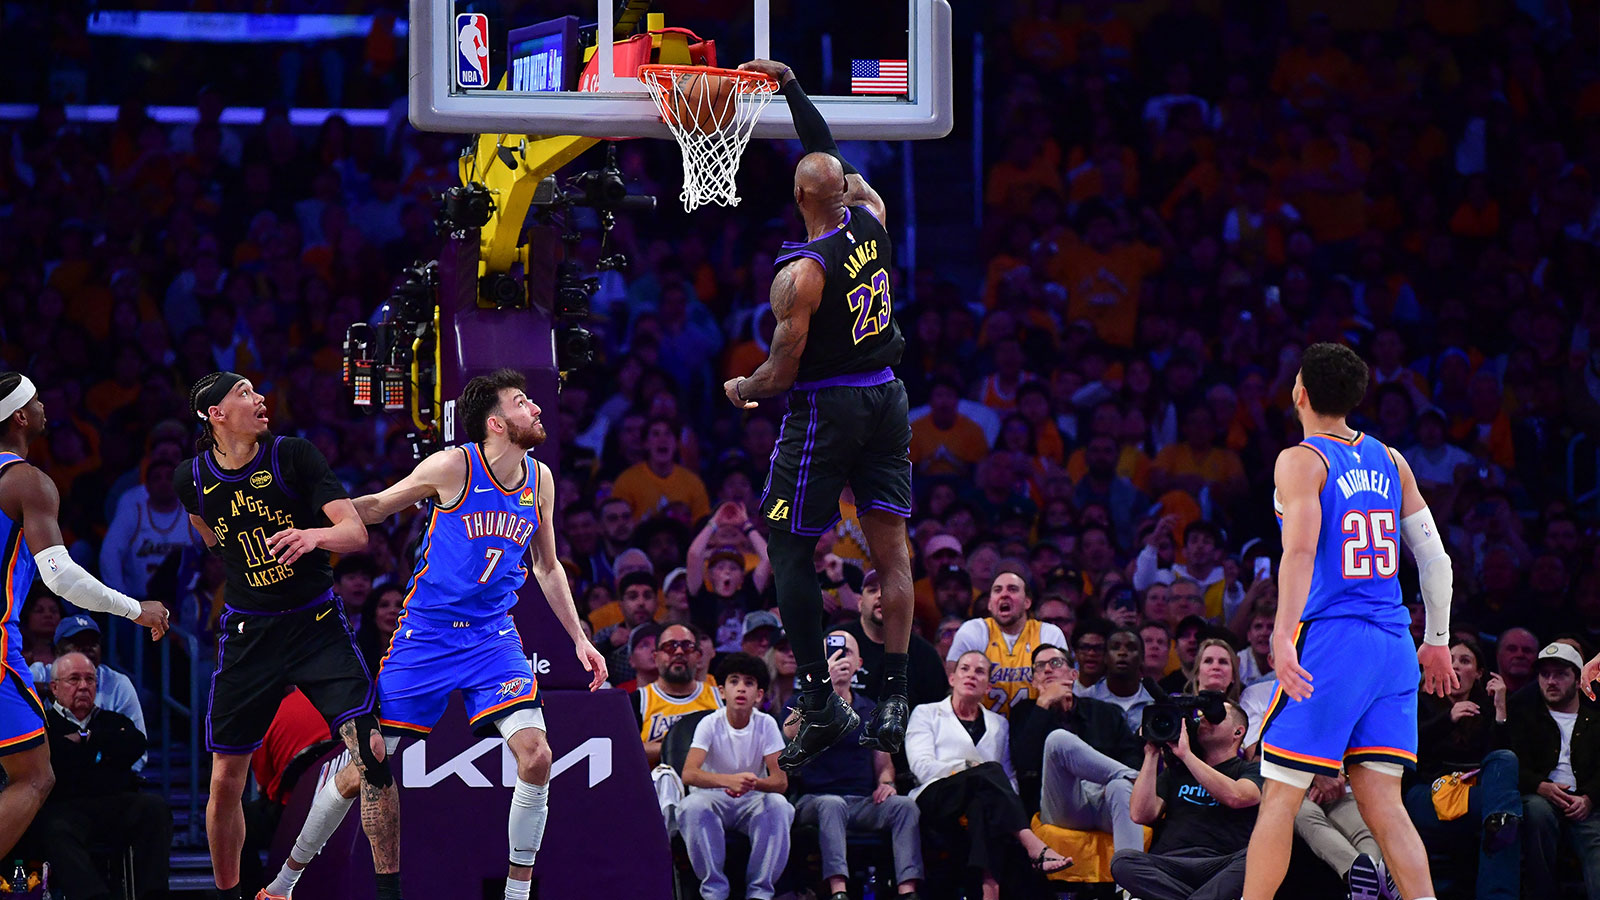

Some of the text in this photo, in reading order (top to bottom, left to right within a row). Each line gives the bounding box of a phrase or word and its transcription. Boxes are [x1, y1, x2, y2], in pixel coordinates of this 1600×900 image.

[462, 70, 478, 83] NBA
[843, 239, 878, 279] JAMES
[846, 267, 892, 346] 23
[1336, 468, 1391, 500] MITCHELL
[231, 489, 295, 530] ANGELES
[237, 526, 277, 569] 11
[460, 510, 535, 549] THUNDER
[1341, 508, 1399, 580] 25
[244, 562, 295, 588] LAKERS
[476, 546, 505, 585] 7
[990, 662, 1033, 684] LAKER
[402, 737, 613, 789] KIA
